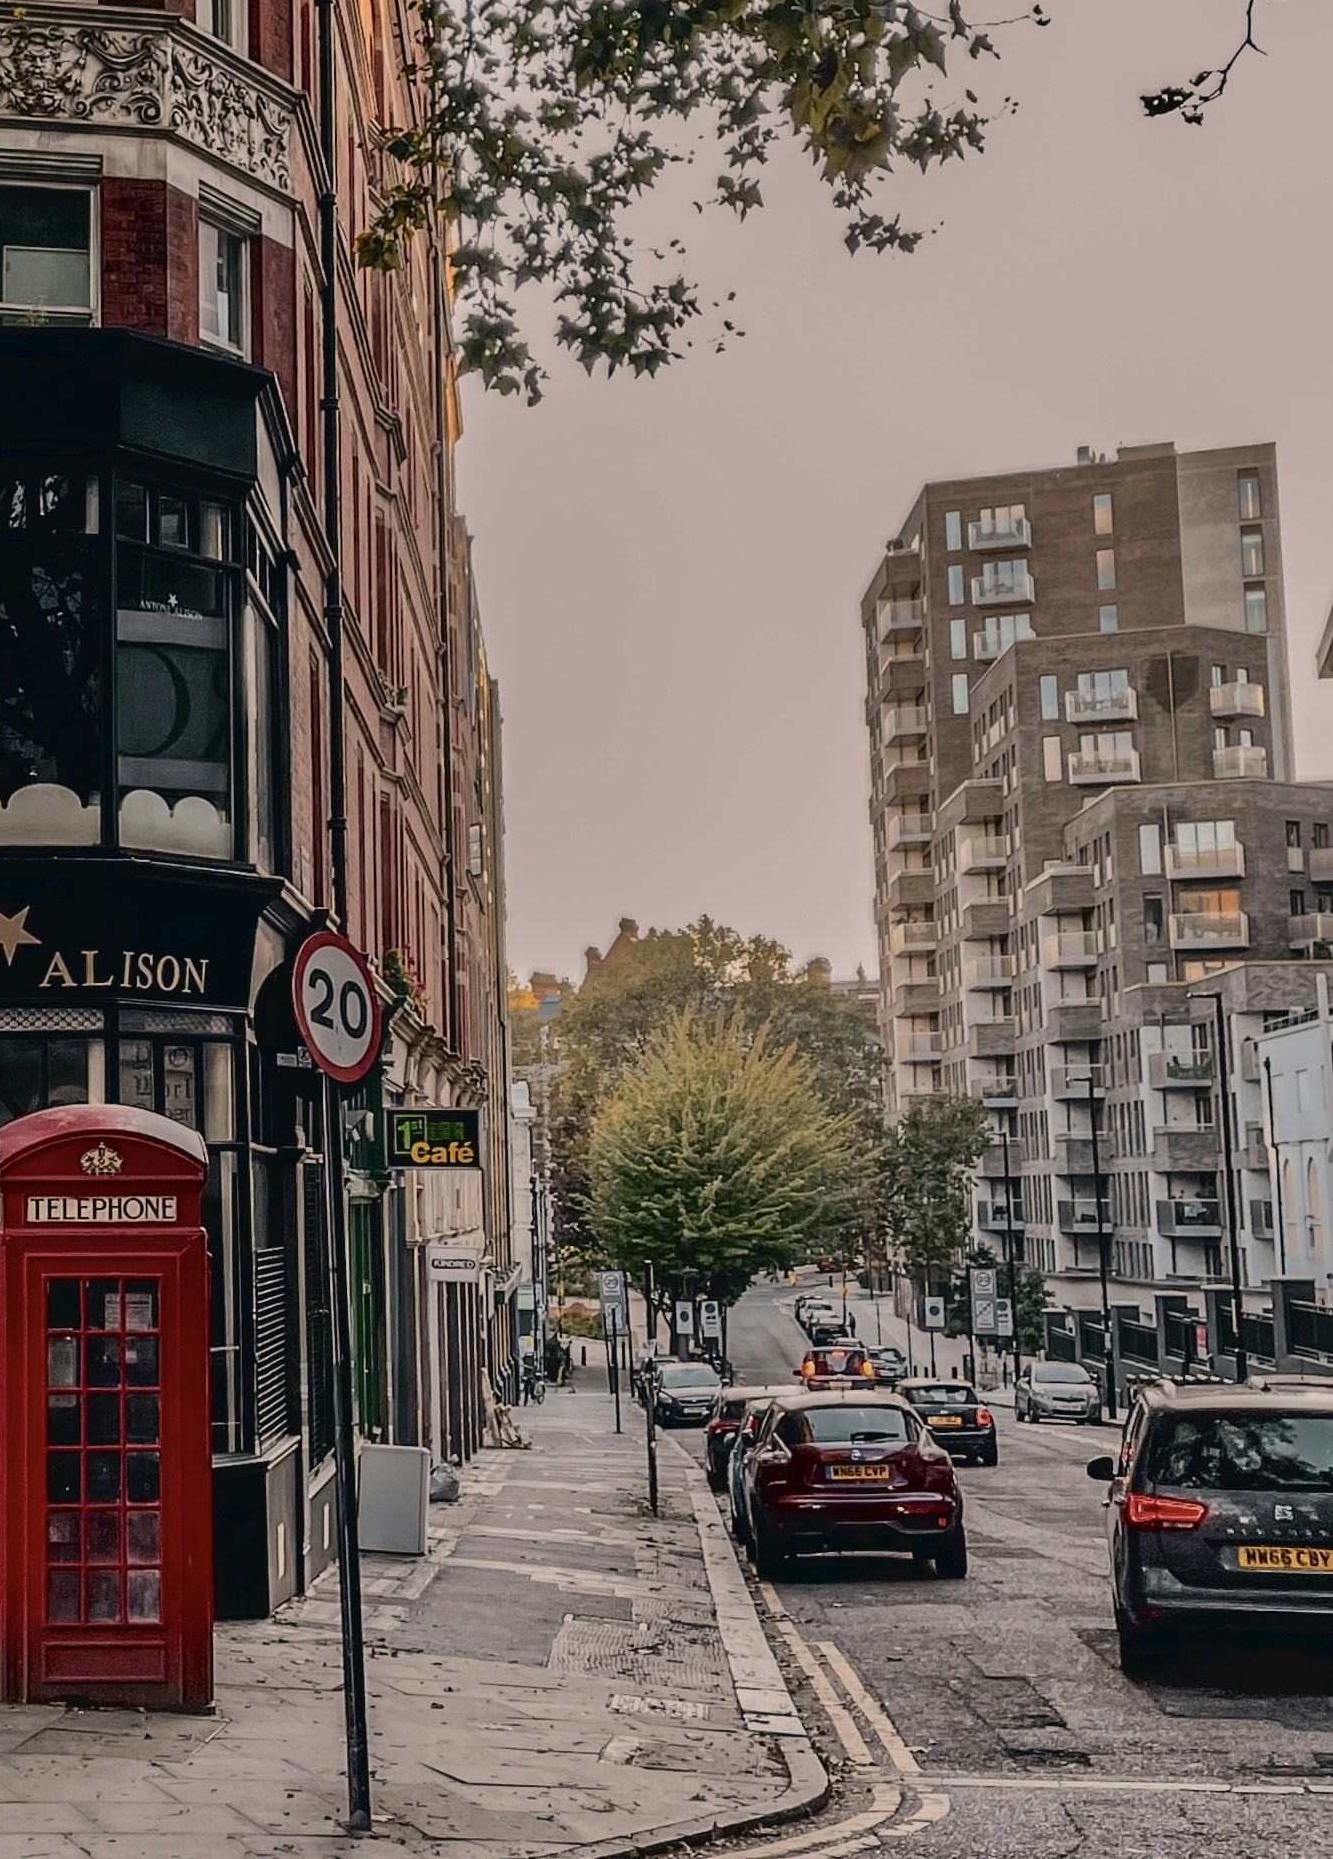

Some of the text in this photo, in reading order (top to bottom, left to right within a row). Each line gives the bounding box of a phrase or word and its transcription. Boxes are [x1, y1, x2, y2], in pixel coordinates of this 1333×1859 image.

[38, 950, 210, 994] ALISON
[308, 968, 368, 1040] 20
[397, 1119, 424, 1150] 1st
[410, 1141, 475, 1164] Café
[29, 1197, 176, 1221] TELEPHONE
[433, 1259, 475, 1269] KINDRED
[864, 1465, 887, 1477] CVP
